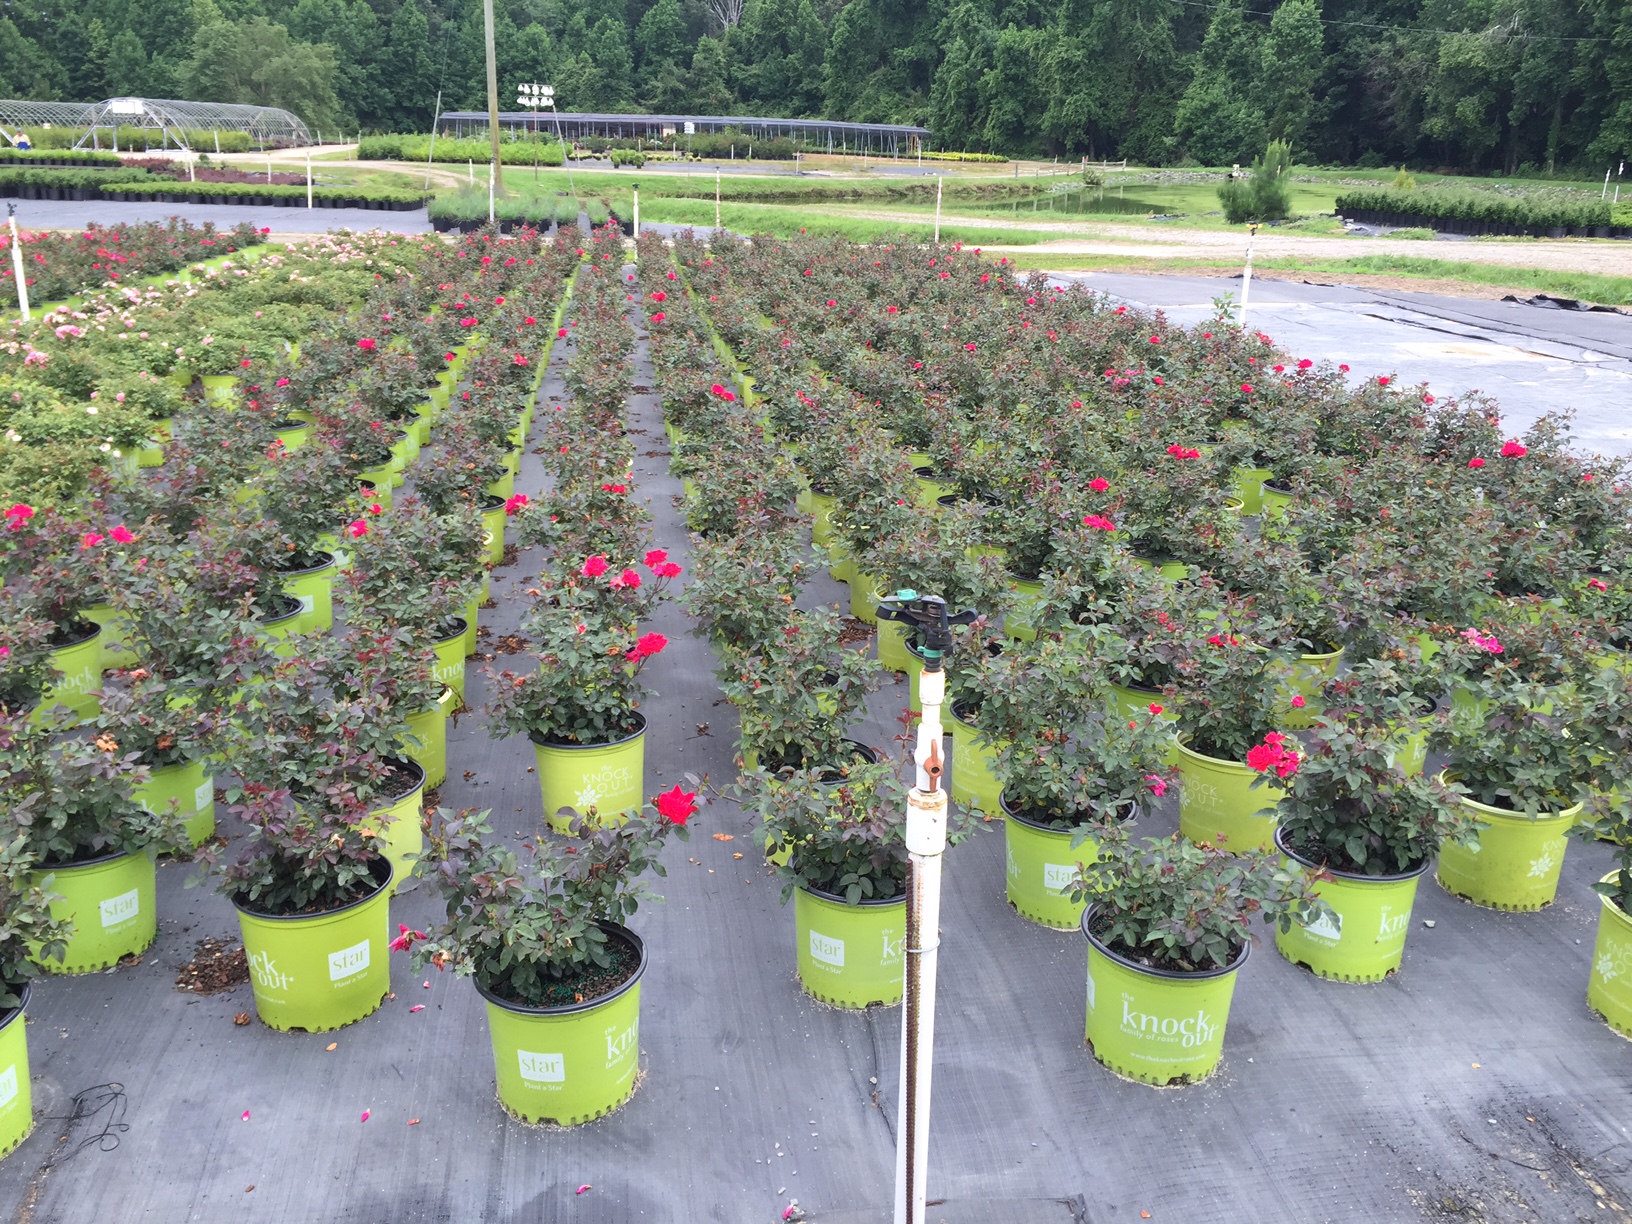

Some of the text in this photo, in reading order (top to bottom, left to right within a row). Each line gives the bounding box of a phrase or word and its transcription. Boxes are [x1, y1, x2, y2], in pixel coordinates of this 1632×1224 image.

[582, 767, 628, 784] KNOCK
[597, 776, 629, 793] OUT
[1188, 789, 1219, 807] OUT
[104, 897, 136, 917] star
[812, 938, 841, 957] star
[333, 948, 366, 971] star
[880, 956, 900, 966] family
[257, 972, 289, 991] out
[333, 980, 352, 989] Plant
[357, 971, 369, 980] Star
[1121, 991, 1135, 1002] the
[1121, 999, 1211, 1036] knock
[604, 1025, 617, 1036] the
[1120, 1024, 1144, 1040] family
[1181, 1024, 1215, 1049] out
[522, 1057, 560, 1074] star
[524, 1081, 541, 1091] Plant
[547, 1084, 563, 1092] Star
